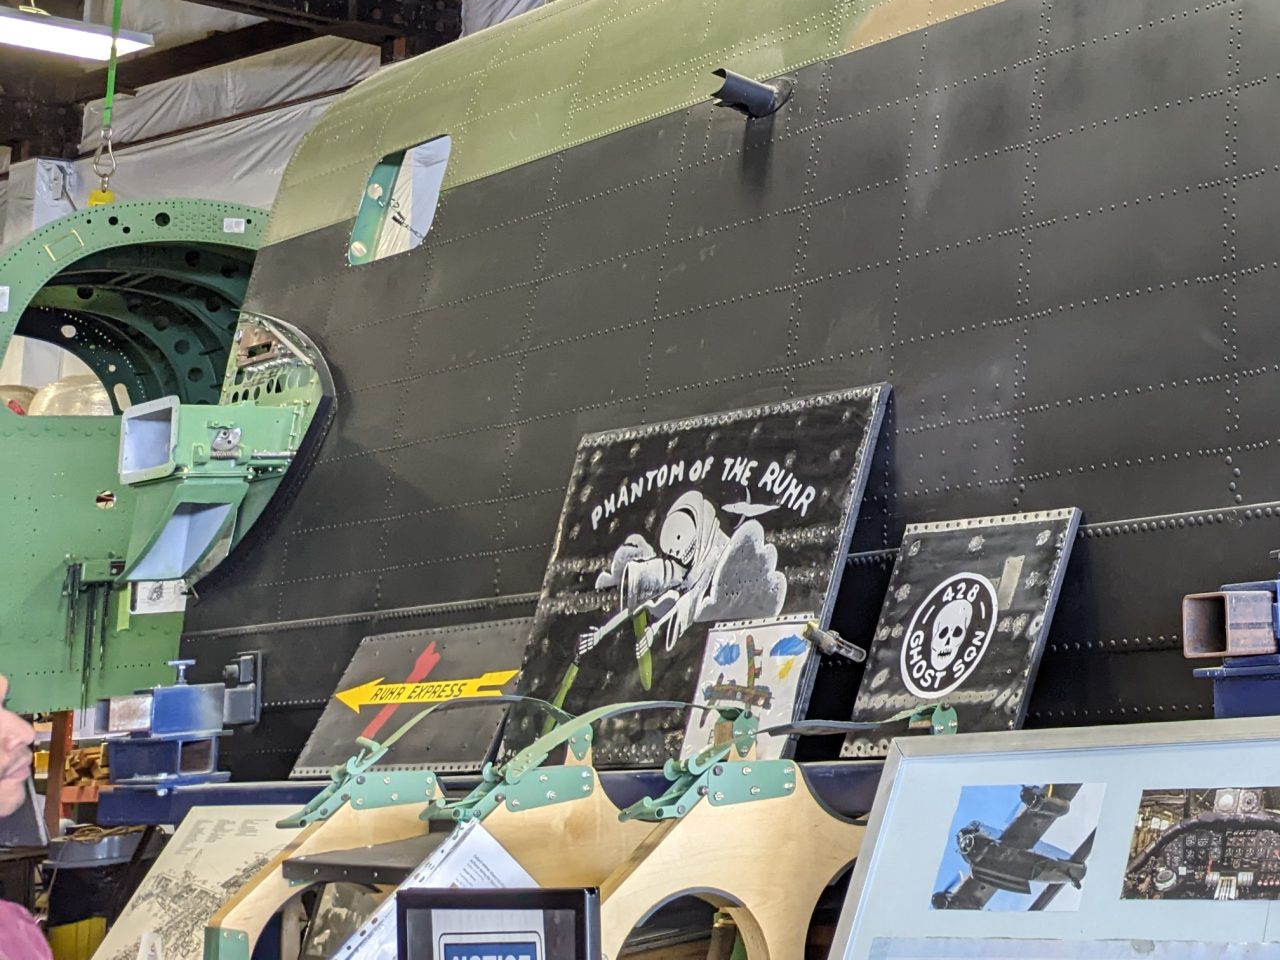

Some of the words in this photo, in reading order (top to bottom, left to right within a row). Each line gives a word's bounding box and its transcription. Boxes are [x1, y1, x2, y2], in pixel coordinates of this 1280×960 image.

[591, 460, 684, 530] PHANTOM
[689, 456, 714, 482] OF
[721, 456, 758, 486] THE
[758, 461, 816, 518] RUHR
[943, 582, 980, 602] 428
[910, 630, 946, 688] GHOST
[953, 631, 985, 678] SQN
[370, 687, 406, 701] RUHR
[407, 683, 467, 700] EXPRESS
